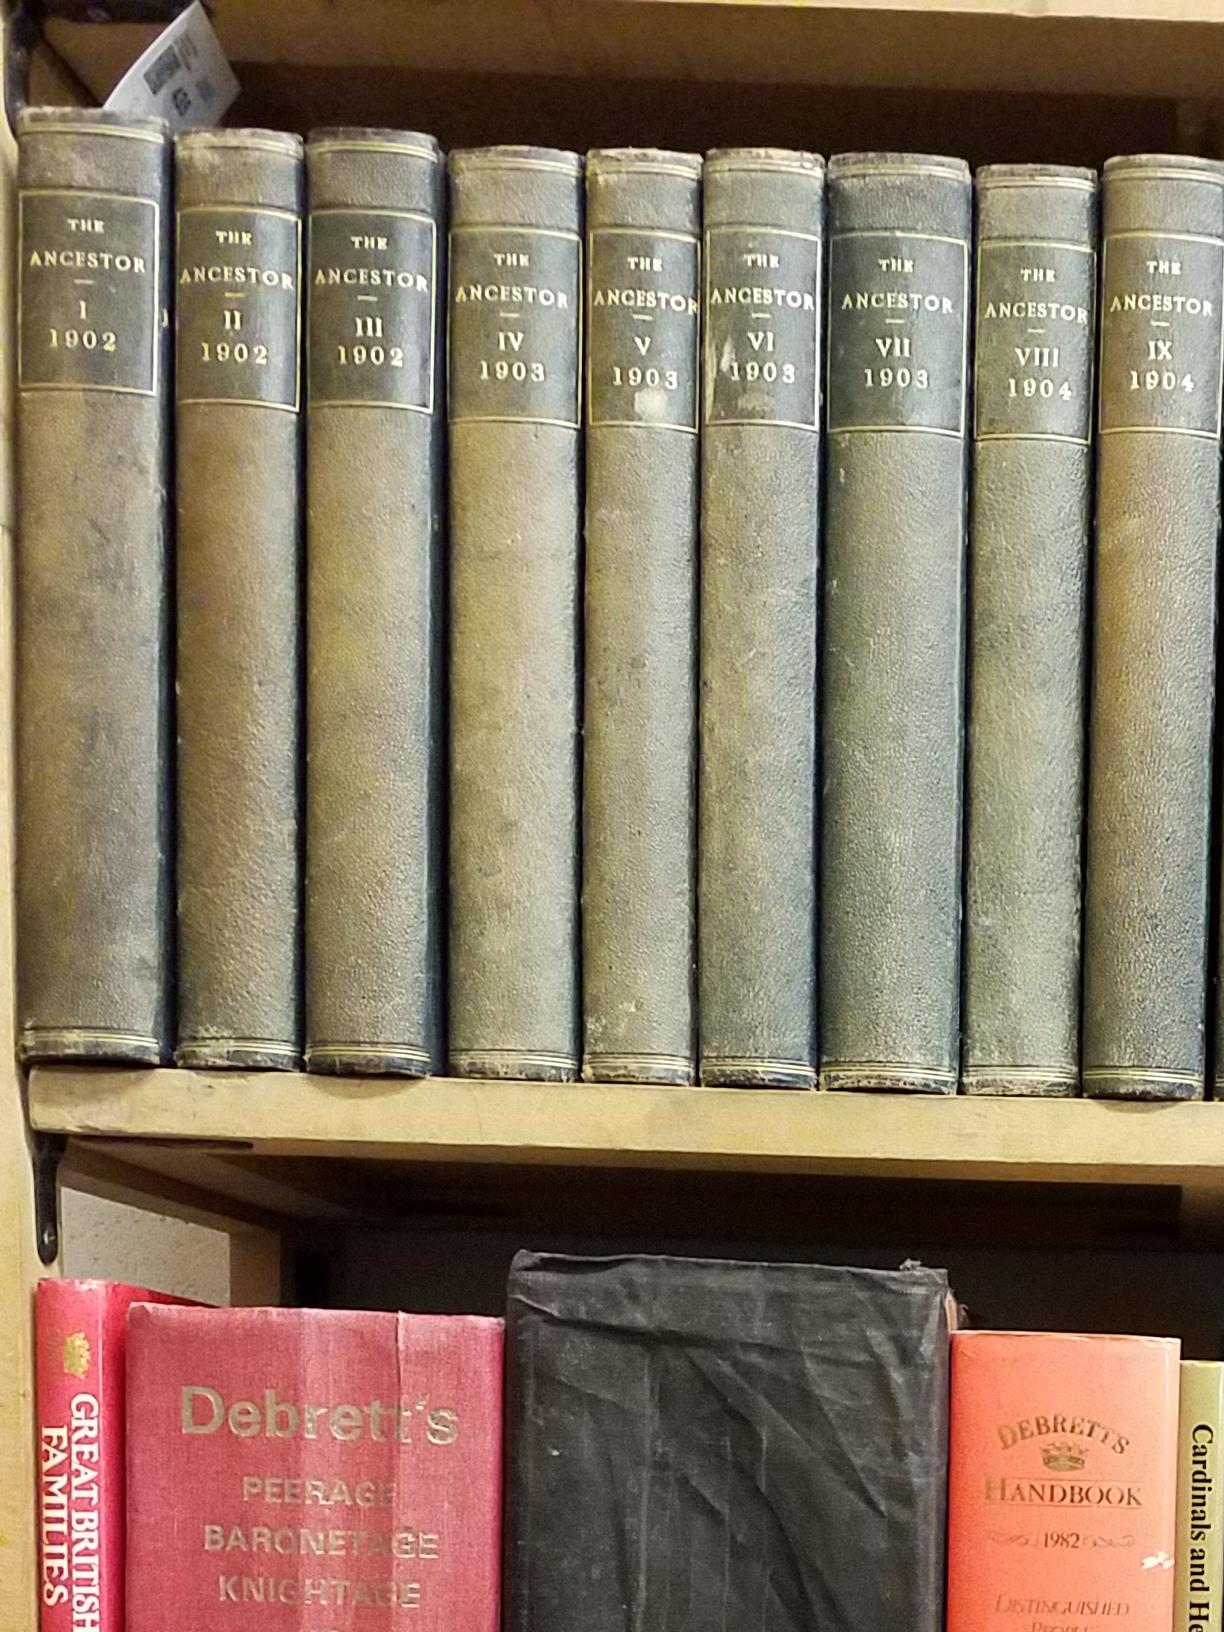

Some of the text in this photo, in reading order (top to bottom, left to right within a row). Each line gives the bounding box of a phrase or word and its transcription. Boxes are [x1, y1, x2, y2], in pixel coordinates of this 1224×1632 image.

[68, 218, 105, 234] THE
[216, 230, 253, 246] THE
[350, 236, 388, 251] THE
[29, 250, 146, 274] ANCESTOR
[494, 253, 530, 267] THE
[627, 257, 663, 272] THE
[744, 254, 780, 269] THE
[879, 258, 914, 273] THE
[1146, 260, 1181, 275] THE
[179, 268, 294, 290] ANCESTOR
[314, 268, 429, 292] ANCESTOR
[1020, 268, 1056, 283] THE
[456, 285, 568, 309] ANCESTOR
[593, 289, 698, 316] ANCESTOR
[711, 287, 815, 311] ANCESTOR
[841, 292, 953, 314] ANCESTOR
[1110, 294, 1213, 316] ANCESTOR
[79, 301, 87, 320] I
[223, 310, 242, 331] II
[985, 302, 1088, 323] ANCESTOR
[354, 316, 383, 338] III
[49, 328, 118, 352] 1902
[498, 332, 525, 352] IV
[634, 337, 652, 356] V
[748, 332, 775, 352] VI
[875, 338, 911, 357] VII
[1148, 340, 1173, 361] IX
[201, 343, 268, 365] 1902
[337, 345, 404, 368] 1902
[1015, 347, 1060, 368] VIII
[480, 360, 546, 382] 1903
[612, 367, 679, 390] 1903
[730, 362, 796, 384] 1903
[863, 368, 930, 389] 1903
[1129, 370, 1195, 392] 1904
[1007, 378, 1072, 400] 1904
[181, 1386, 458, 1445] Debrett's
[69, 1392, 99, 1506] GREAT
[243, 1476, 397, 1506] PEERAGE
[985, 1476, 1142, 1506] HANDBOOK
[1190, 1423, 1214, 1541] Cardinals
[41, 1424, 69, 1607] FAMILIES
[204, 1524, 439, 1559] BARONETAGE
[1043, 1532, 1080, 1549] 1982
[1189, 1547, 1210, 1592] and
[218, 1575, 420, 1608] KNIGHTAGE
